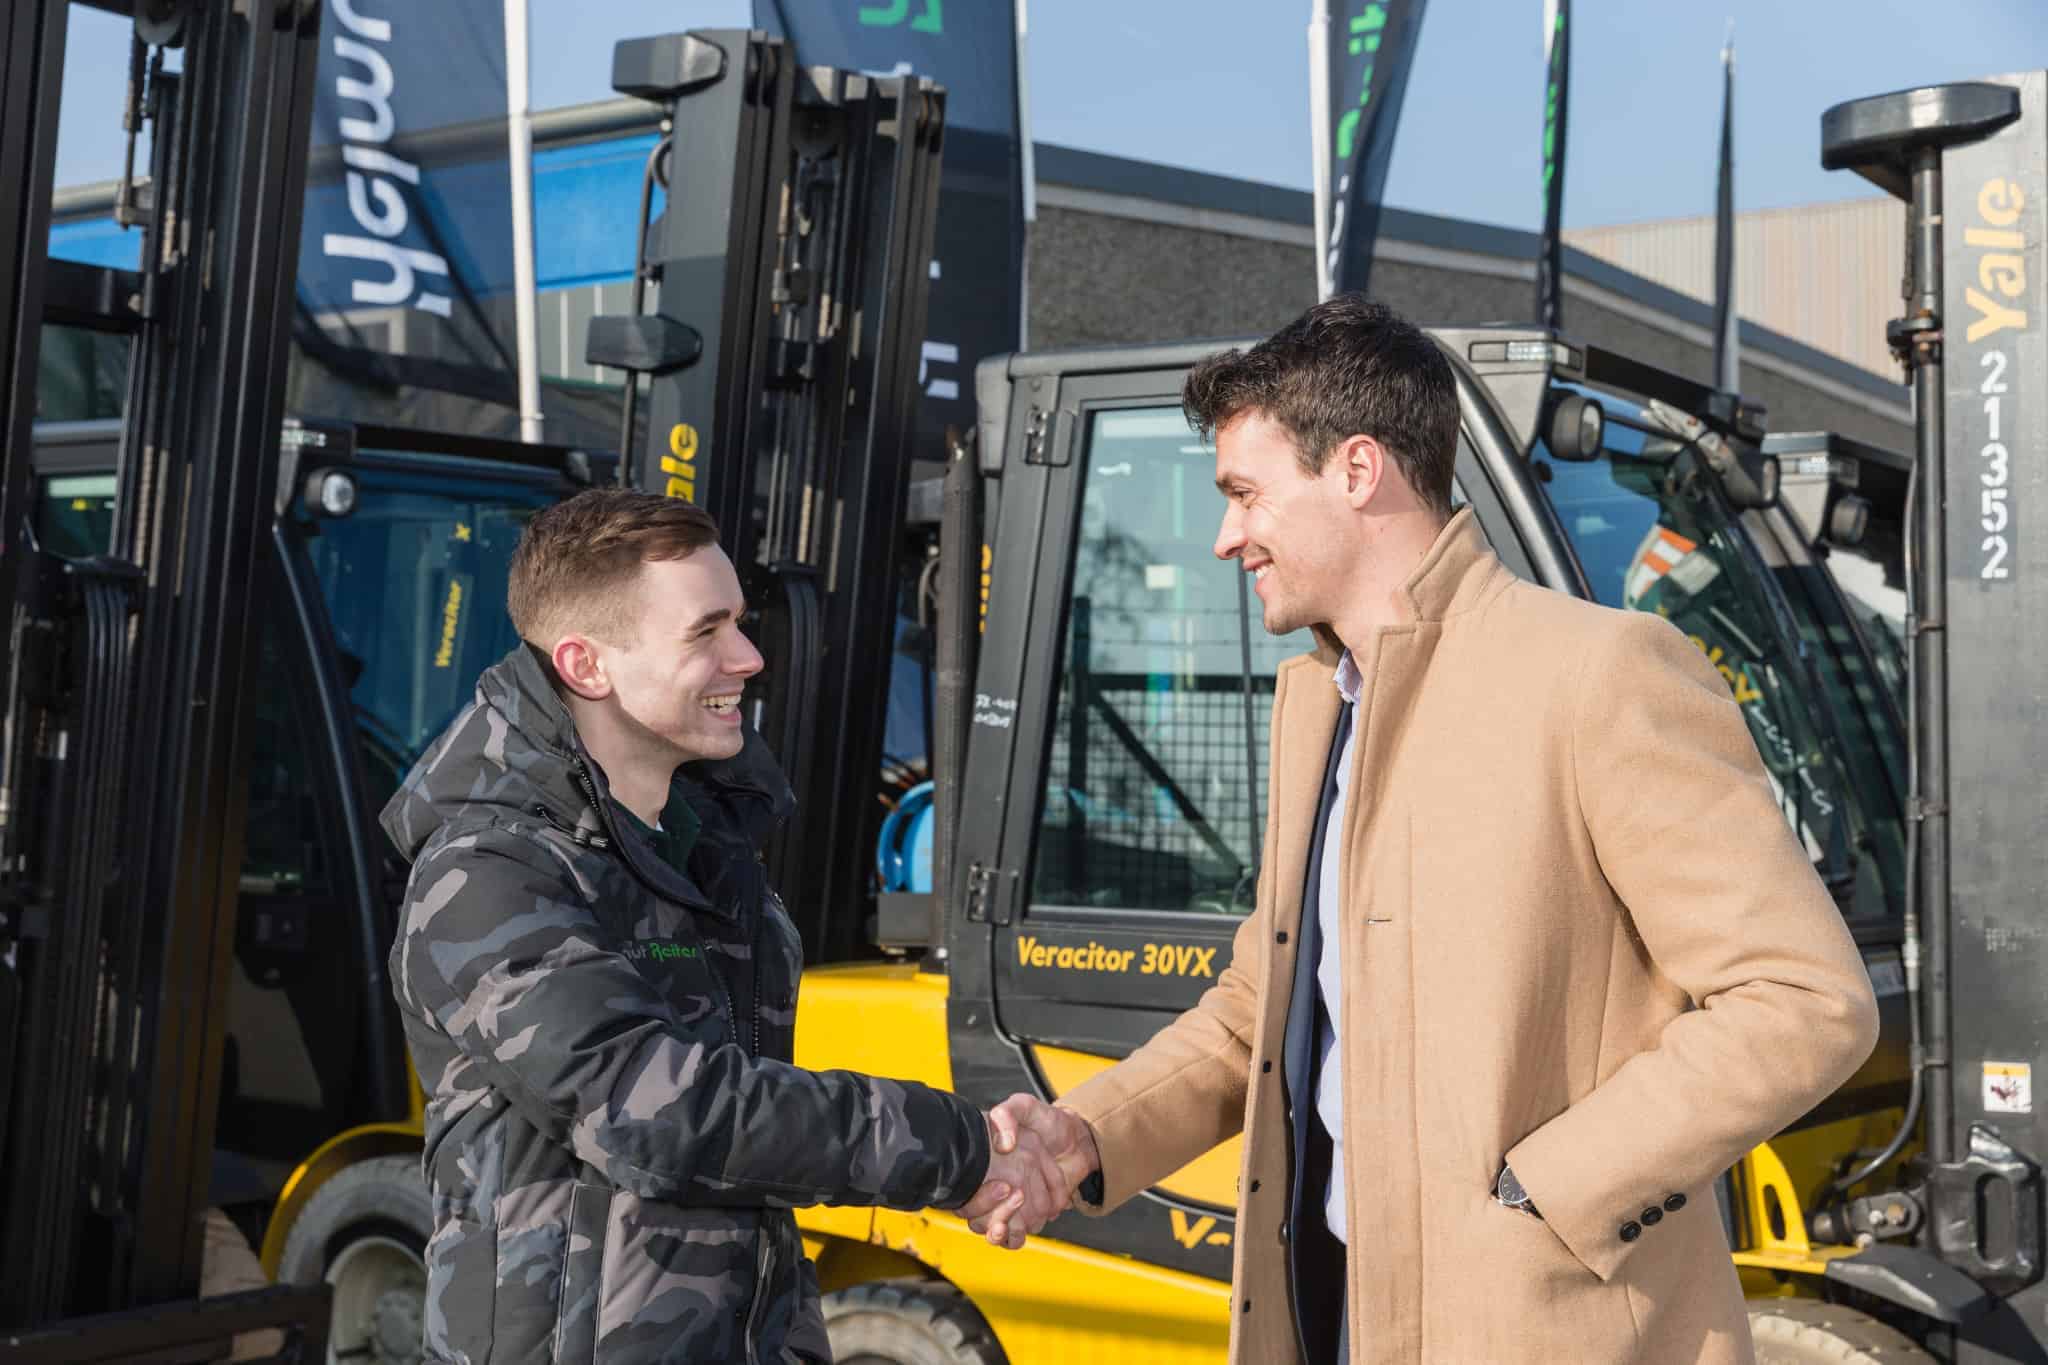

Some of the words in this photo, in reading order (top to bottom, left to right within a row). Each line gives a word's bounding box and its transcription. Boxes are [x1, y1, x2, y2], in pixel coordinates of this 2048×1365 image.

[1965, 177, 2027, 343] Yale
[660, 423, 699, 504] ale
[1980, 350, 2009, 579] 21352
[1017, 936, 1135, 972] Veracitor
[1140, 943, 1217, 978] 30VX
